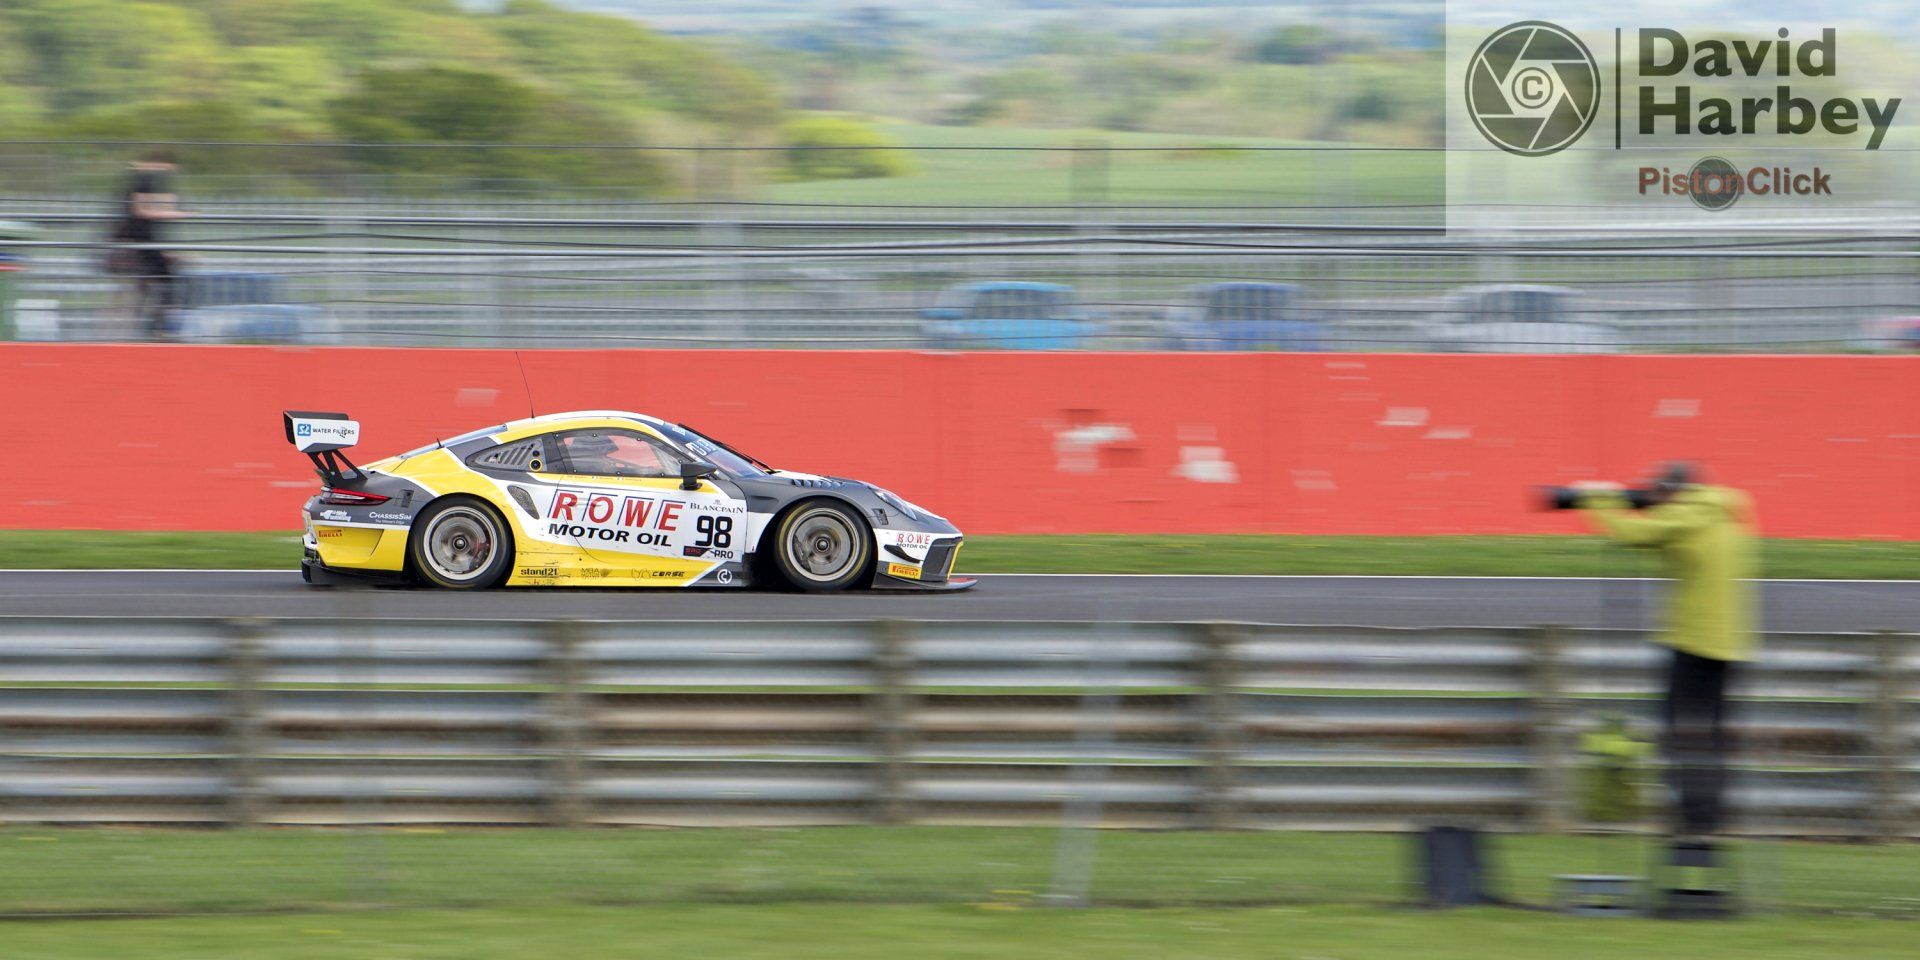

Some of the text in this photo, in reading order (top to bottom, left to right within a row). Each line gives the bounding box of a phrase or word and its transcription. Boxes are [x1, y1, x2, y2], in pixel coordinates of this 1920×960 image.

[551, 492, 684, 532] ROWE
[690, 502, 744, 514] BLANCPAIN
[548, 523, 672, 547] MOTOR OIL
[694, 515, 733, 549] 98
[897, 533, 931, 544] ROWE
[714, 549, 734, 560] PRO
[520, 567, 558, 576] stand21
